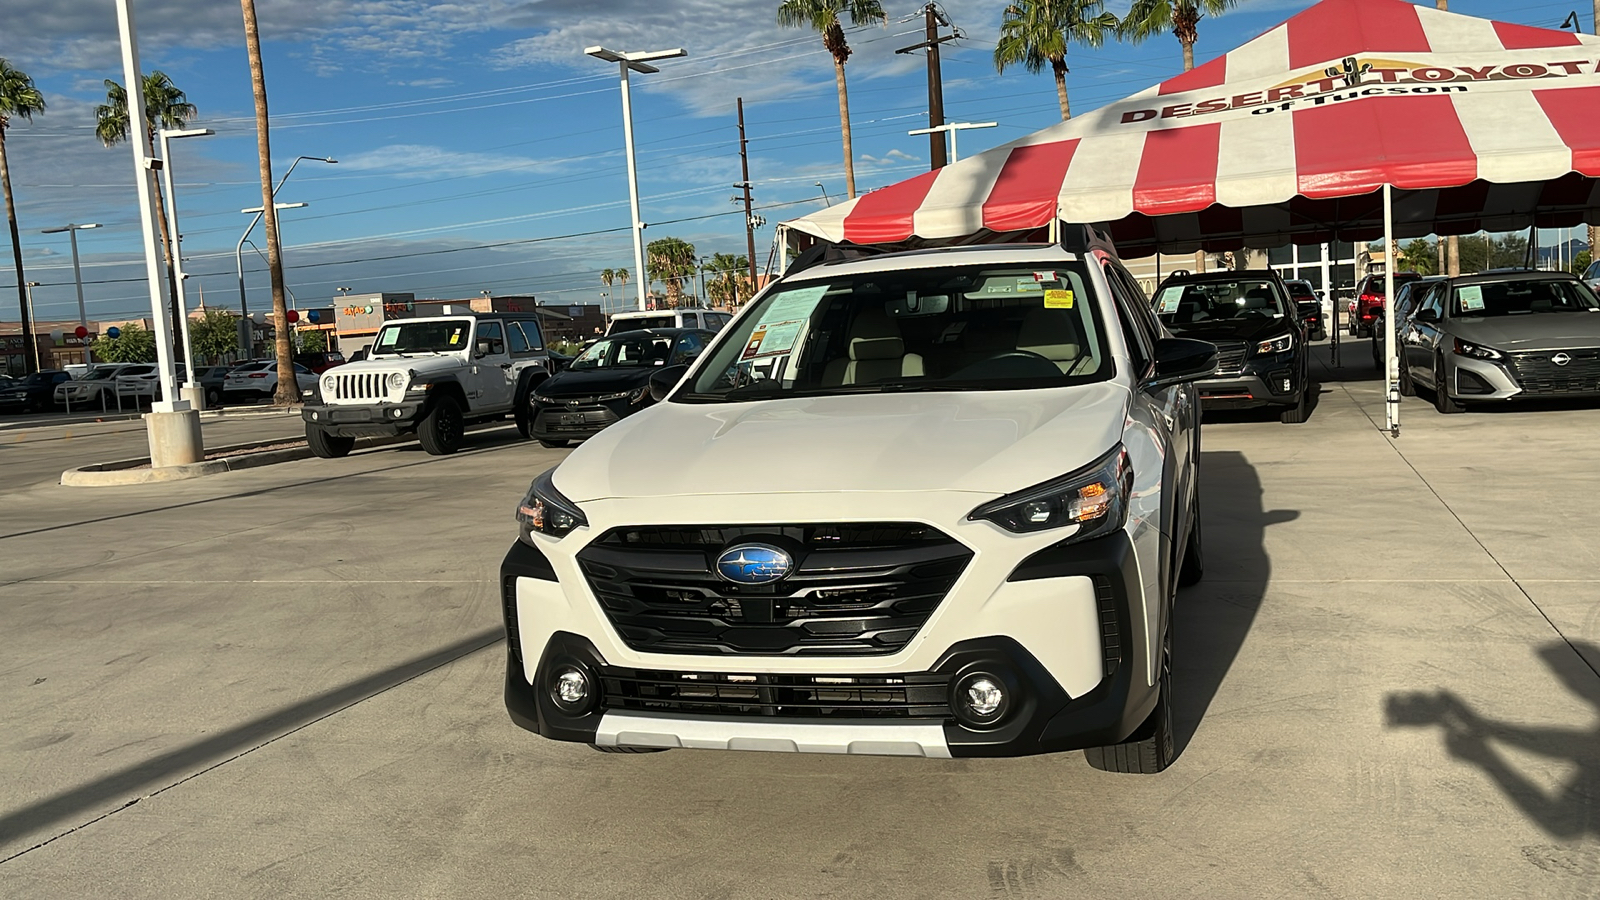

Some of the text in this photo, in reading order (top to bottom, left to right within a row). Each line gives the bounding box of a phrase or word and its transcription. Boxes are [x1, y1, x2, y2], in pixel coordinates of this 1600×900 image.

[1120, 59, 1600, 124] DESERT TOYOT
[1251, 84, 1468, 115] of Tucson
